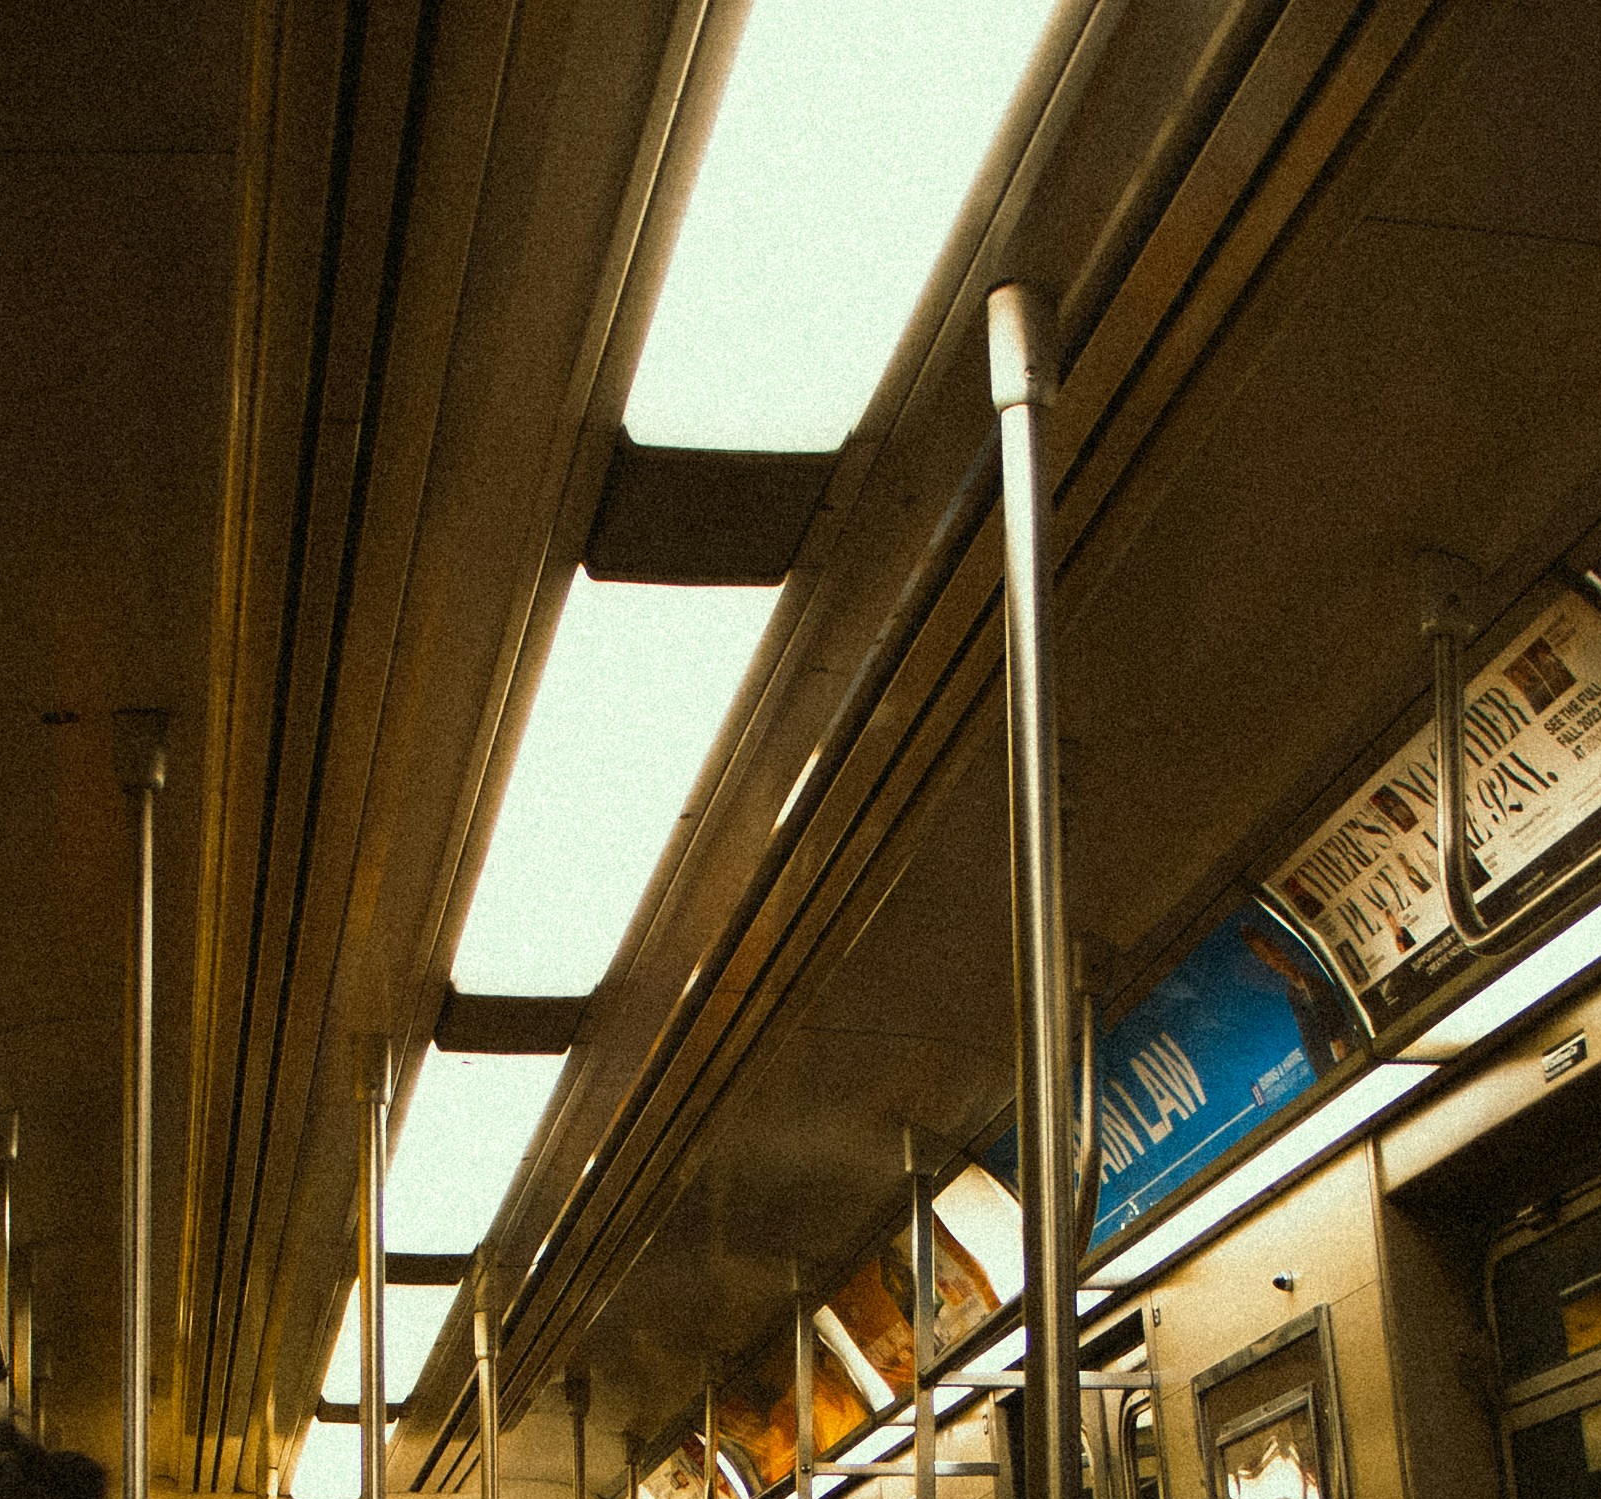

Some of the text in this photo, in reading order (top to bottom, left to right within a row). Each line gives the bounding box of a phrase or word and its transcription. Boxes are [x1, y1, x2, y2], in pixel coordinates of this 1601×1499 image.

[1543, 713, 1566, 736] SEE
[1559, 698, 1585, 720] THE
[1555, 725, 1585, 749] FALL
[1298, 810, 1394, 902] THERE'S
[1109, 1030, 1208, 1146] LAW
